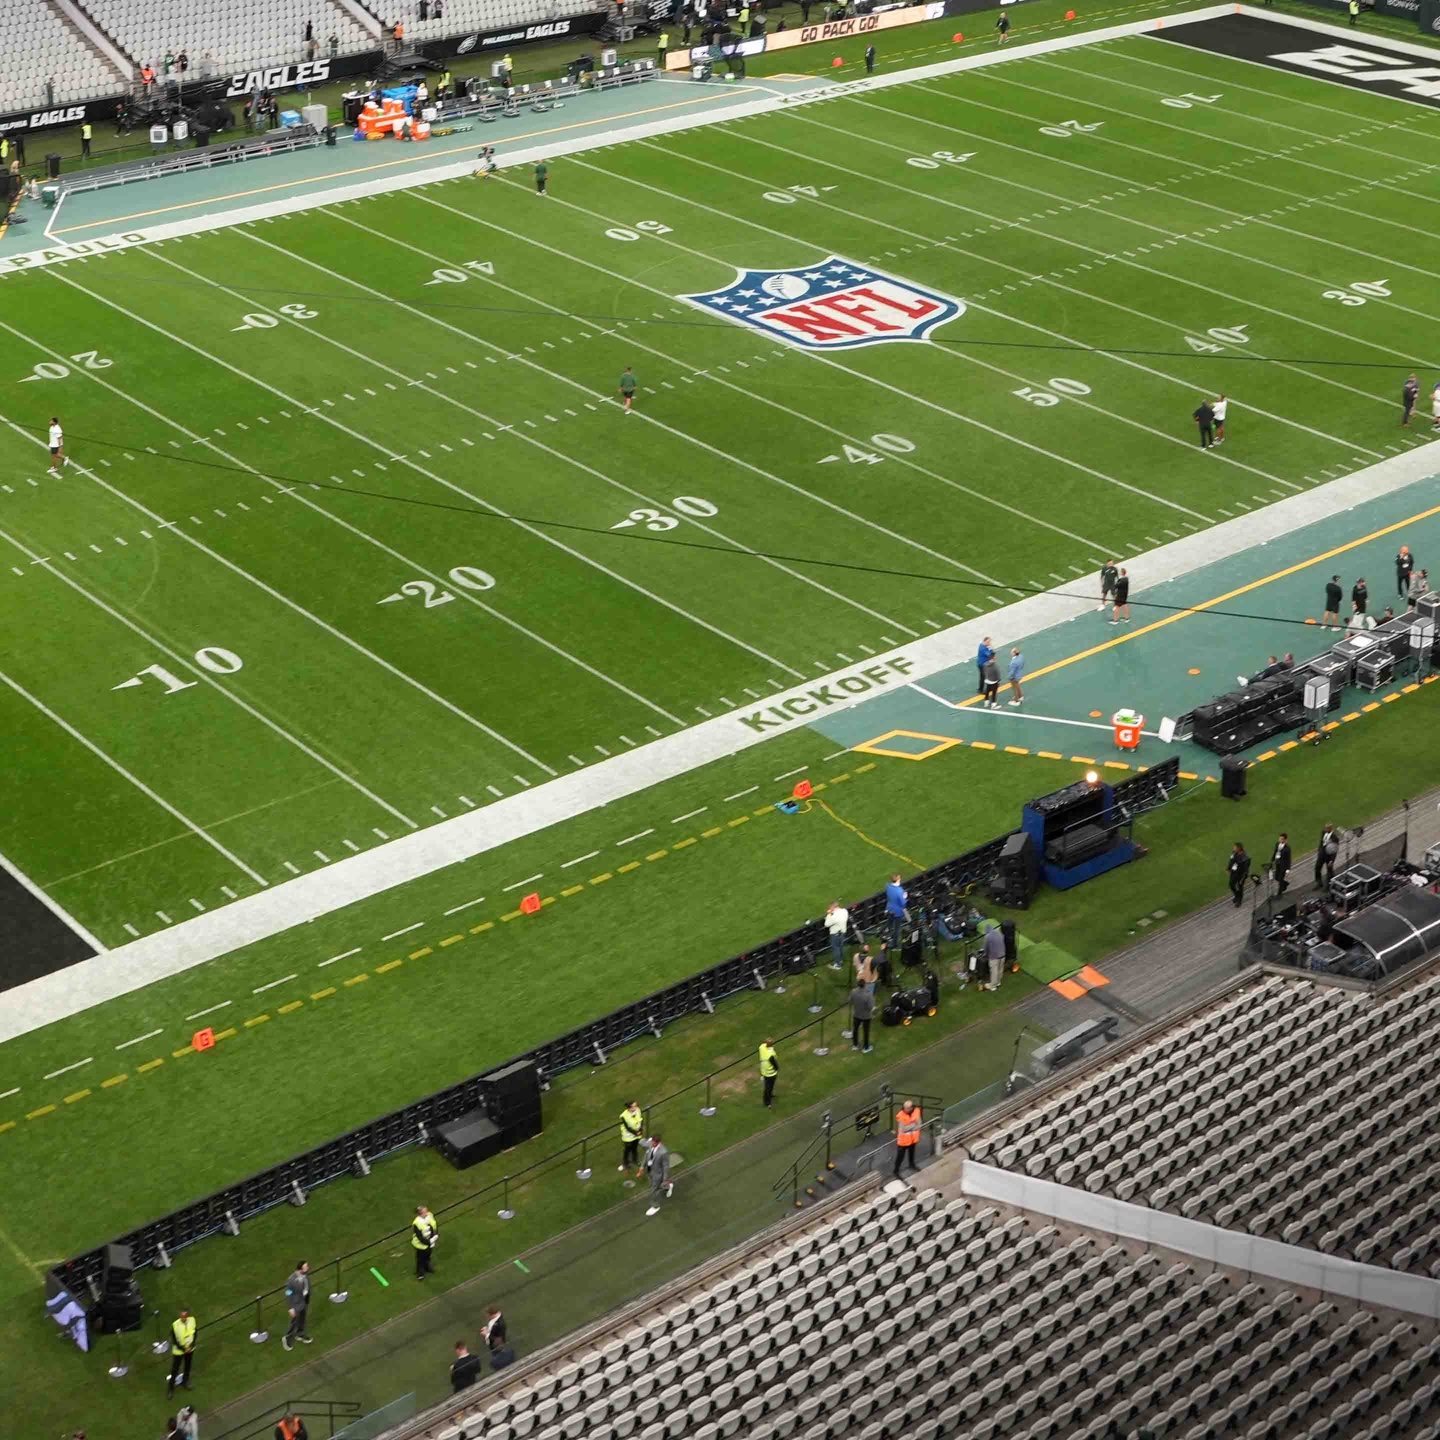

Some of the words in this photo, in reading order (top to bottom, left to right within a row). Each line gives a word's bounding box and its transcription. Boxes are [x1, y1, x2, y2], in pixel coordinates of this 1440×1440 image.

[525, 20, 571, 40] EAGLES
[800, 27, 819, 43] GO
[822, 20, 855, 40] PACK
[859, 15, 880, 32] GO!
[226, 58, 331, 98] EAGLES
[777, 80, 873, 106] KICKOFF
[1160, 92, 1217, 109] 10
[29, 105, 86, 128] EAGLES
[1038, 120, 1097, 138] 20
[906, 151, 969, 169] 30
[762, 184, 821, 204] 40
[605, 220, 674, 242] 50
[9, 233, 147, 268] PAULO
[432, 259, 496, 284] 40
[1322, 281, 1392, 306] 30
[242, 303, 319, 329] 30
[761, 288, 940, 341] NFL
[1184, 326, 1250, 354] 40
[33, 350, 114, 380] 20
[1012, 377, 1092, 408] 50
[842, 433, 916, 466] 40
[629, 495, 720, 532] 30
[401, 566, 497, 609] 20
[137, 646, 244, 695] 10
[738, 656, 915, 733] KICKOFF
[1119, 729, 1133, 742] G
